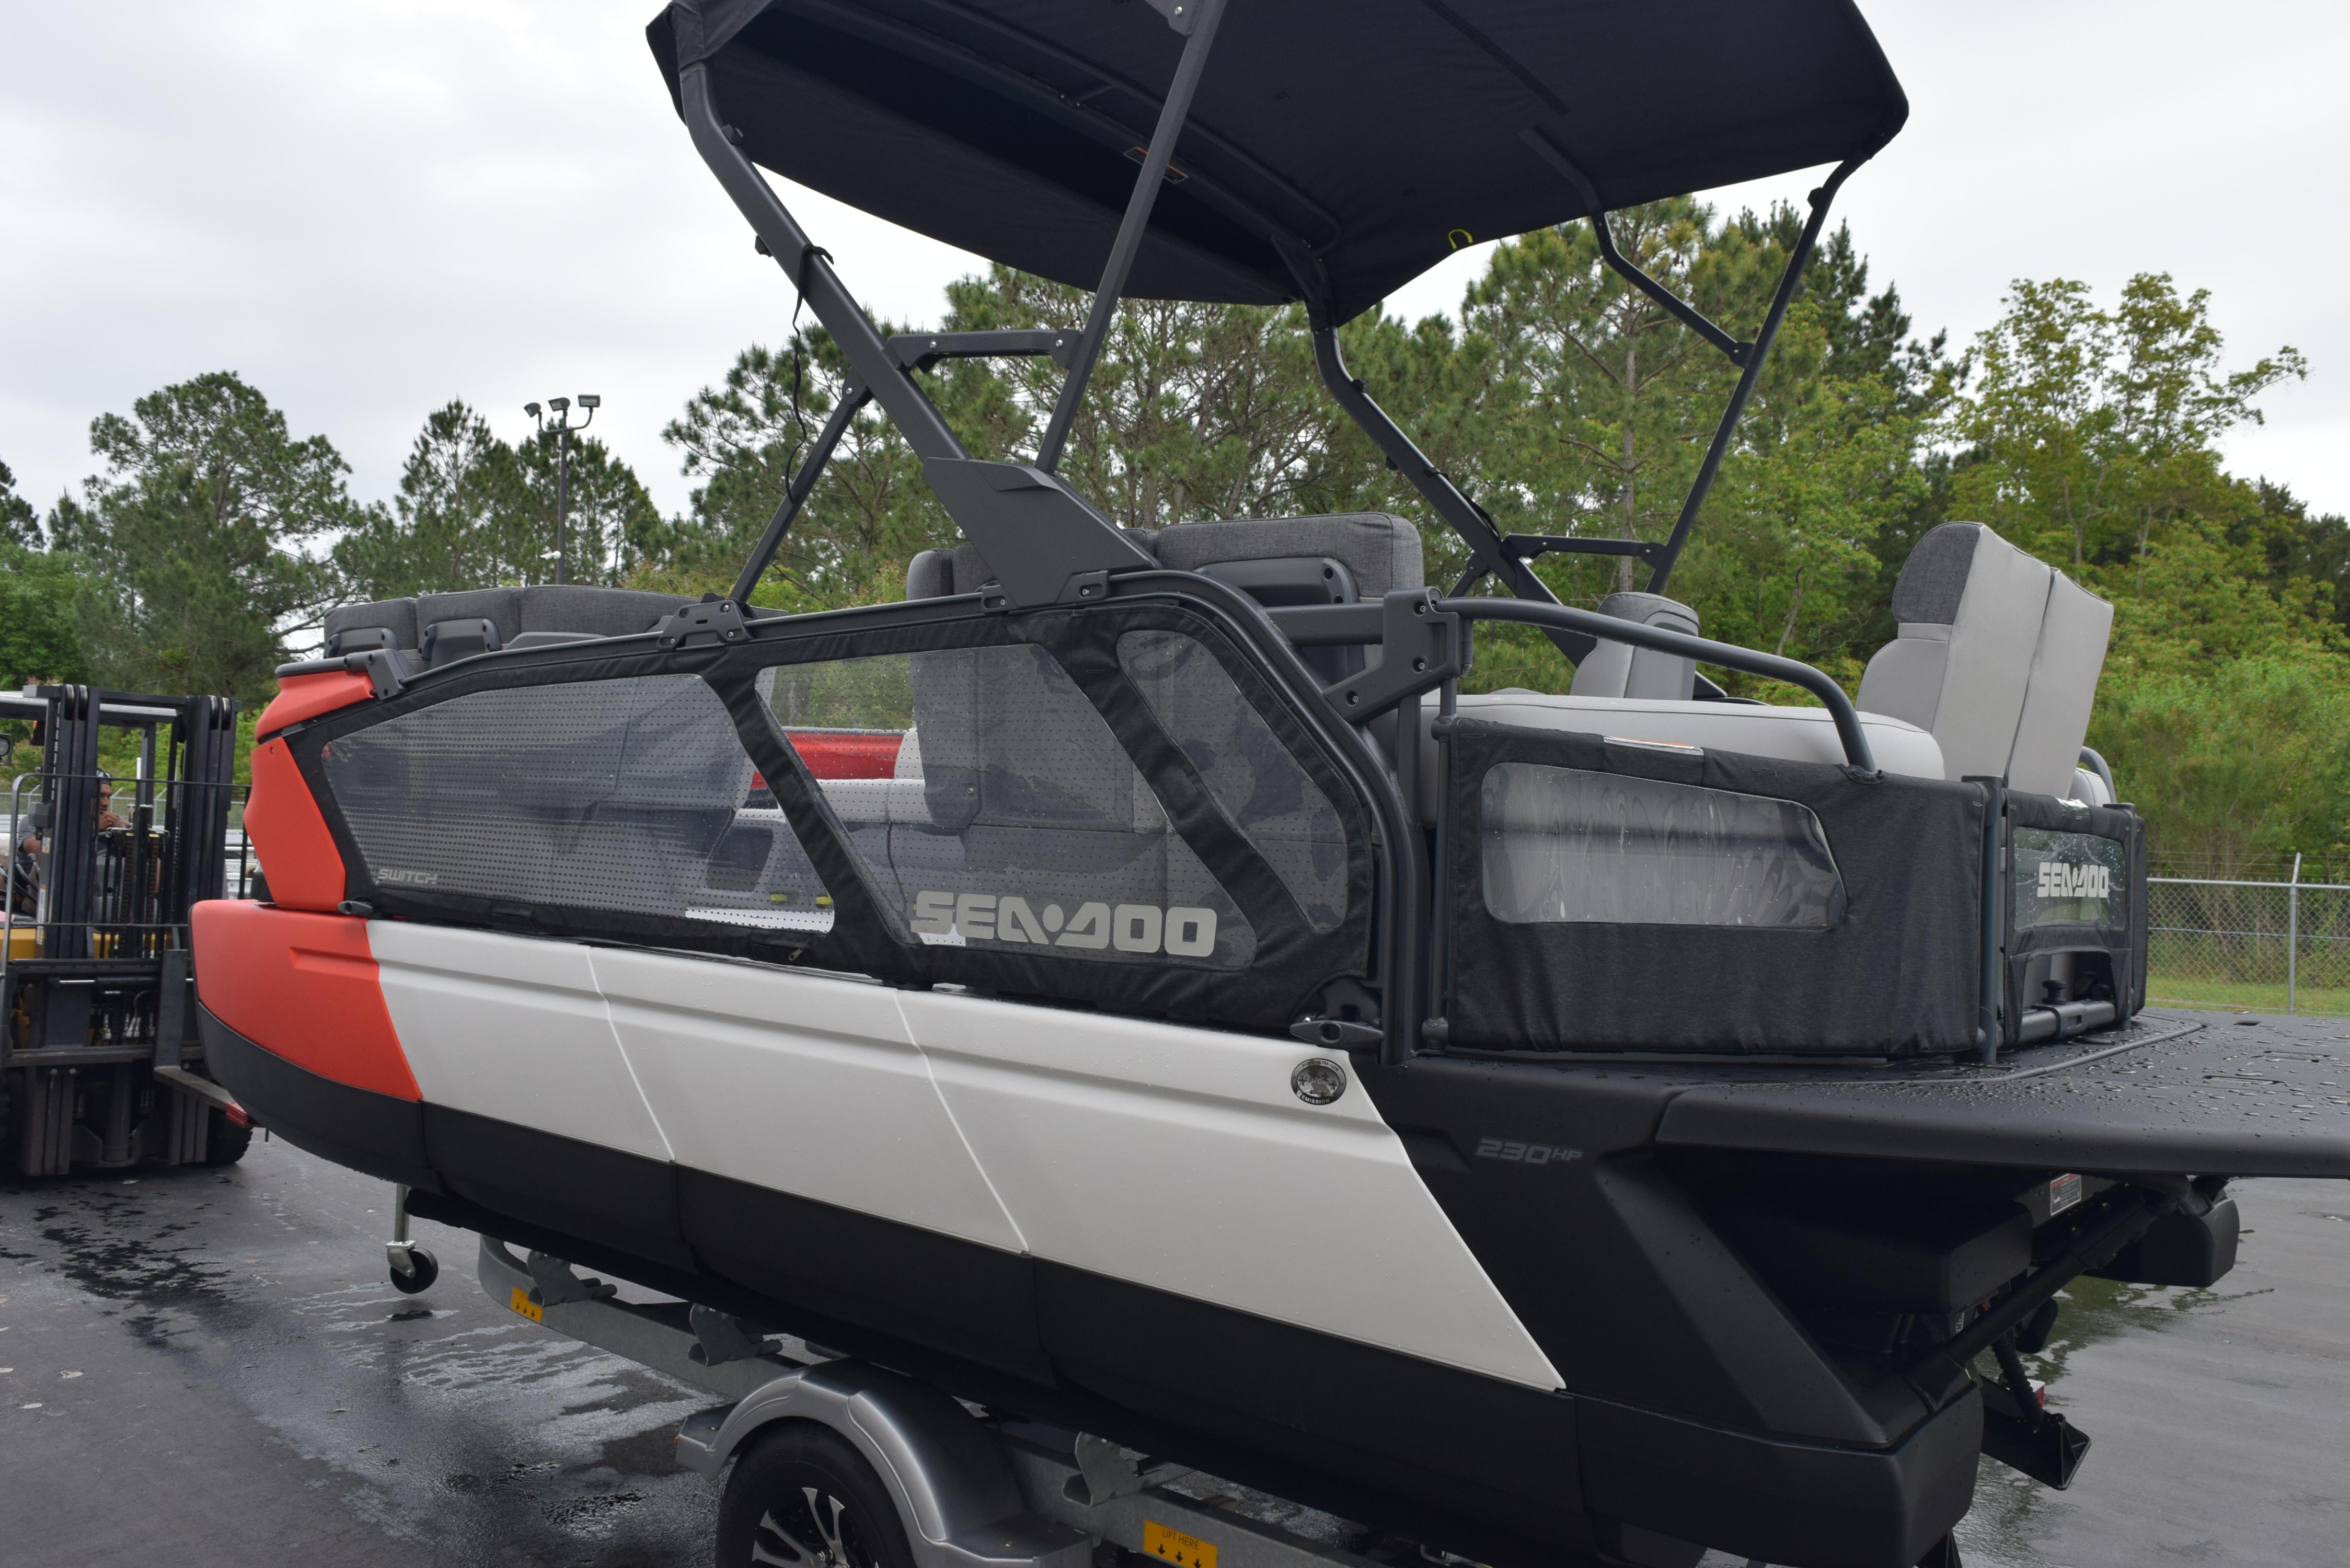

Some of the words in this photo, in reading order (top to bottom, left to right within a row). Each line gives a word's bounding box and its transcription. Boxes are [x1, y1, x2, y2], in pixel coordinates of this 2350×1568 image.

[377, 868, 437, 884] SWITCH
[1301, 1094, 1330, 1104] EMISSION
[1162, 1529, 1176, 1541] LIFT
[1179, 1535, 1199, 1550] HERE
